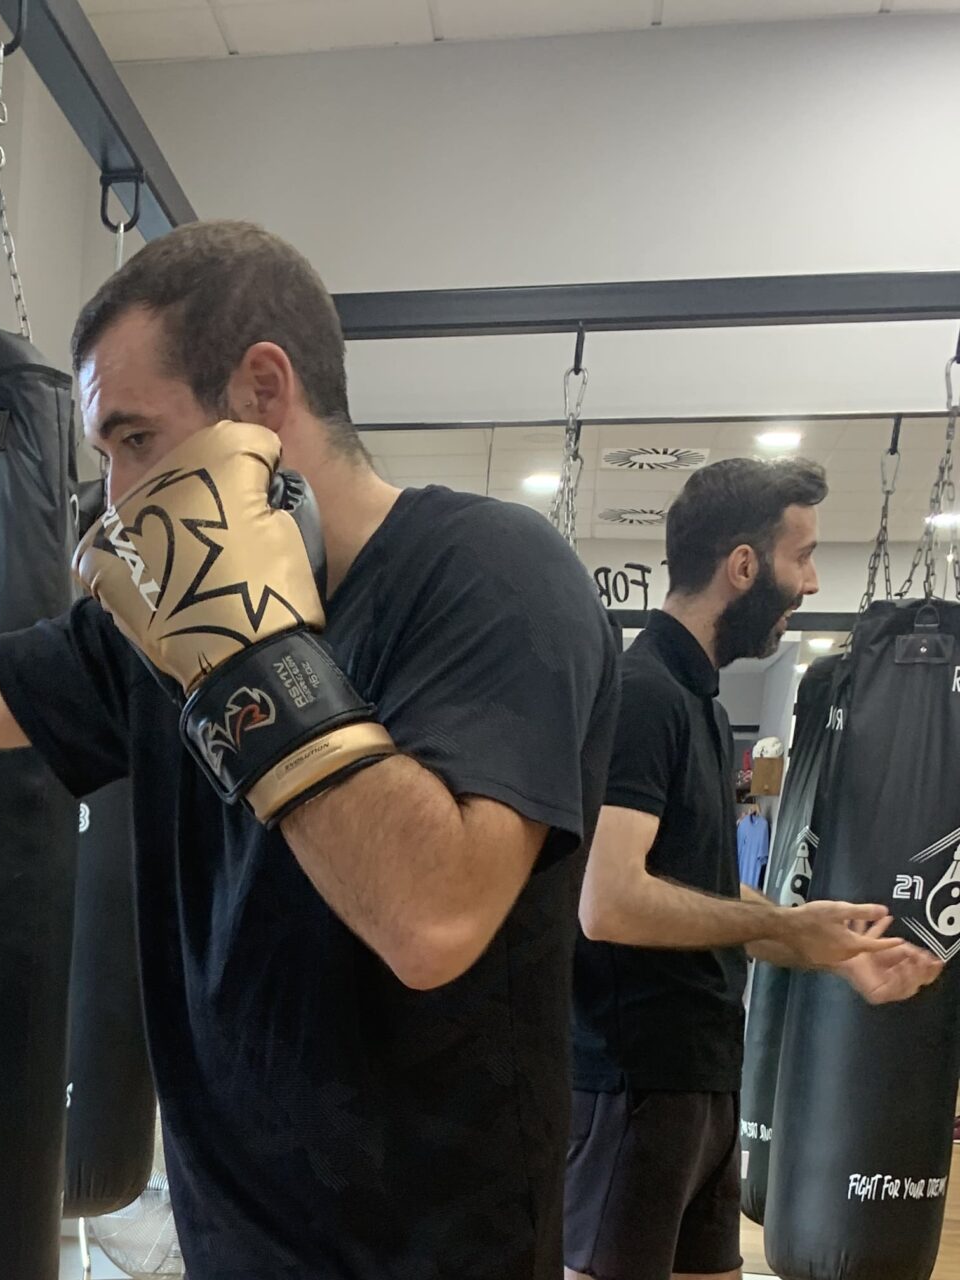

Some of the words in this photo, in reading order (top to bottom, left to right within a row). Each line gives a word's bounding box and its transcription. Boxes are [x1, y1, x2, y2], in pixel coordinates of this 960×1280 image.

[892, 874, 924, 900] 21
[882, 1174, 900, 1200] FOR
[903, 1177, 925, 1200] YOUR
